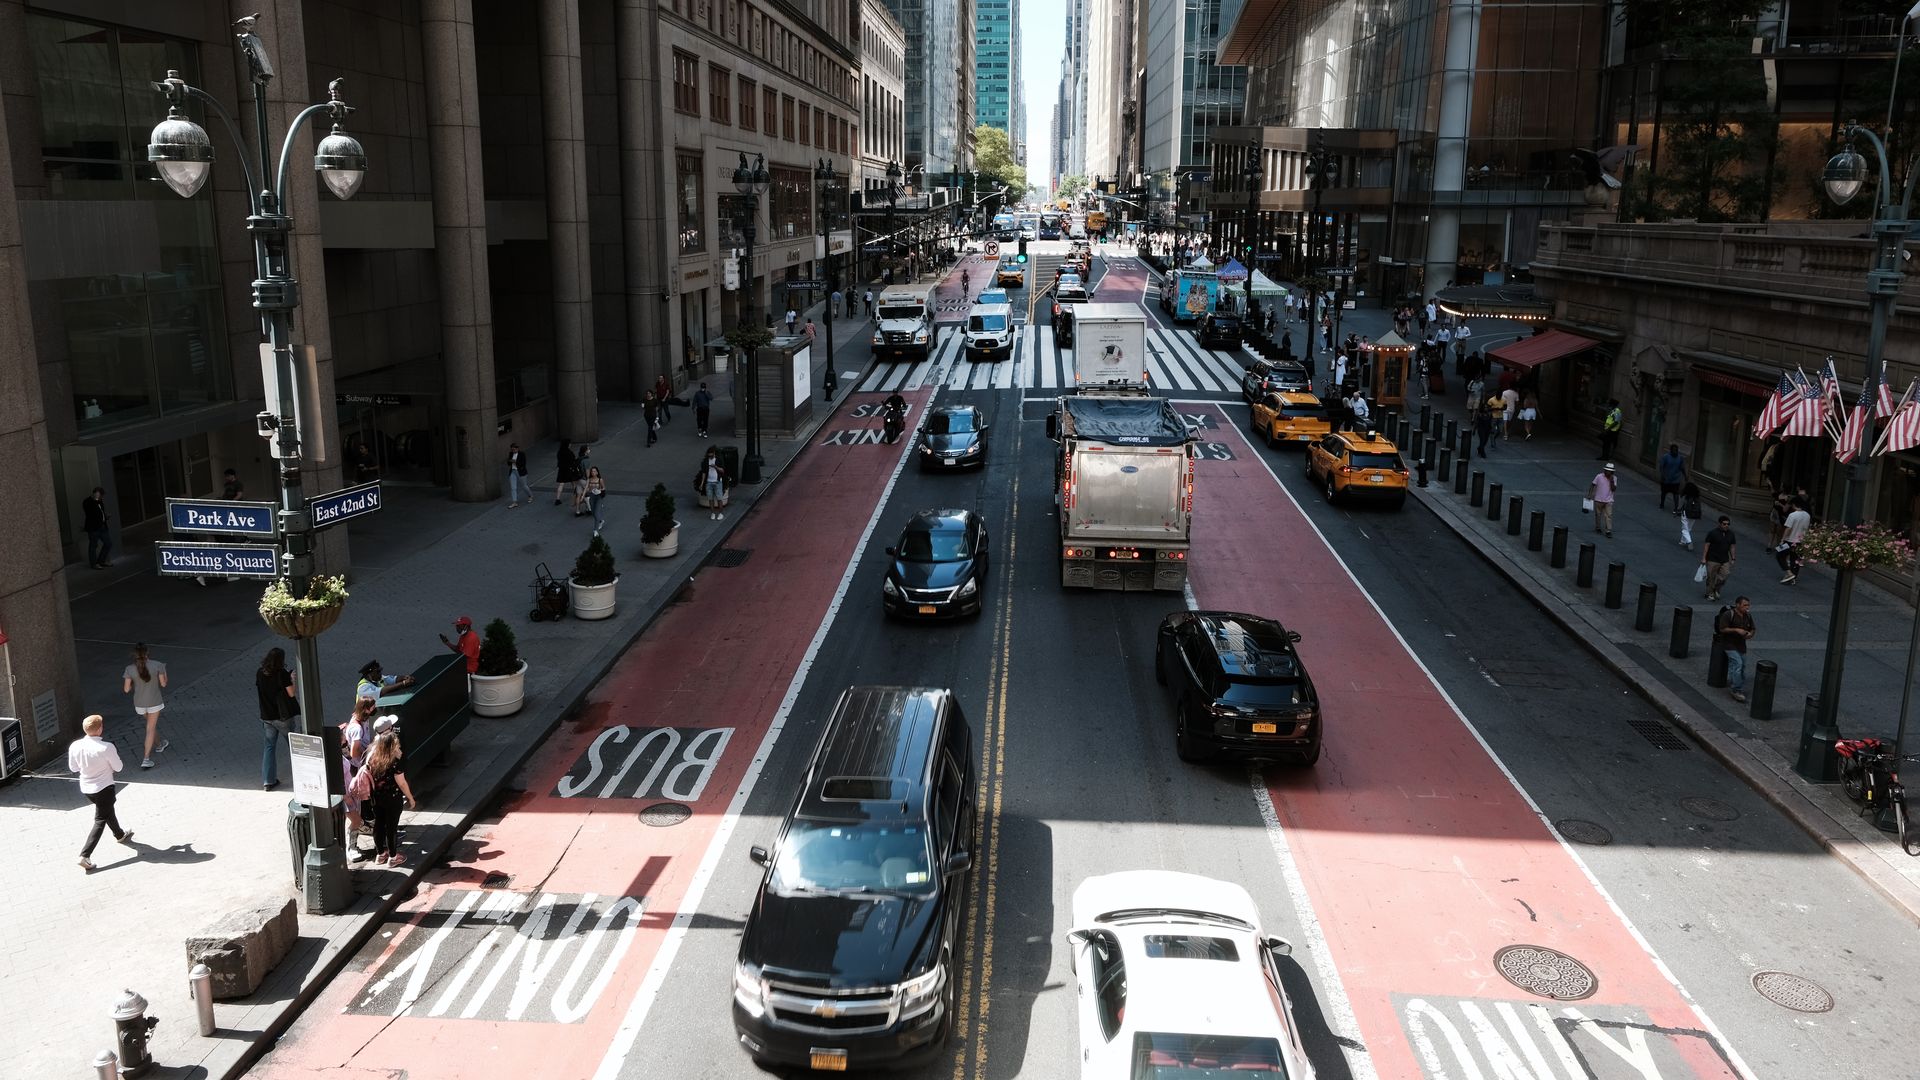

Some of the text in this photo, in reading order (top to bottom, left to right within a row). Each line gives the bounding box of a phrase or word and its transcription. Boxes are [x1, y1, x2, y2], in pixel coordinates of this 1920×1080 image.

[345, 394, 373, 403] Subway
[187, 509, 255, 528] Park Ave
[315, 492, 378, 522] East 42nd St
[162, 552, 273, 570] Pershing Square
[558, 724, 735, 801] BUS
[343, 889, 643, 1023] ONLY
